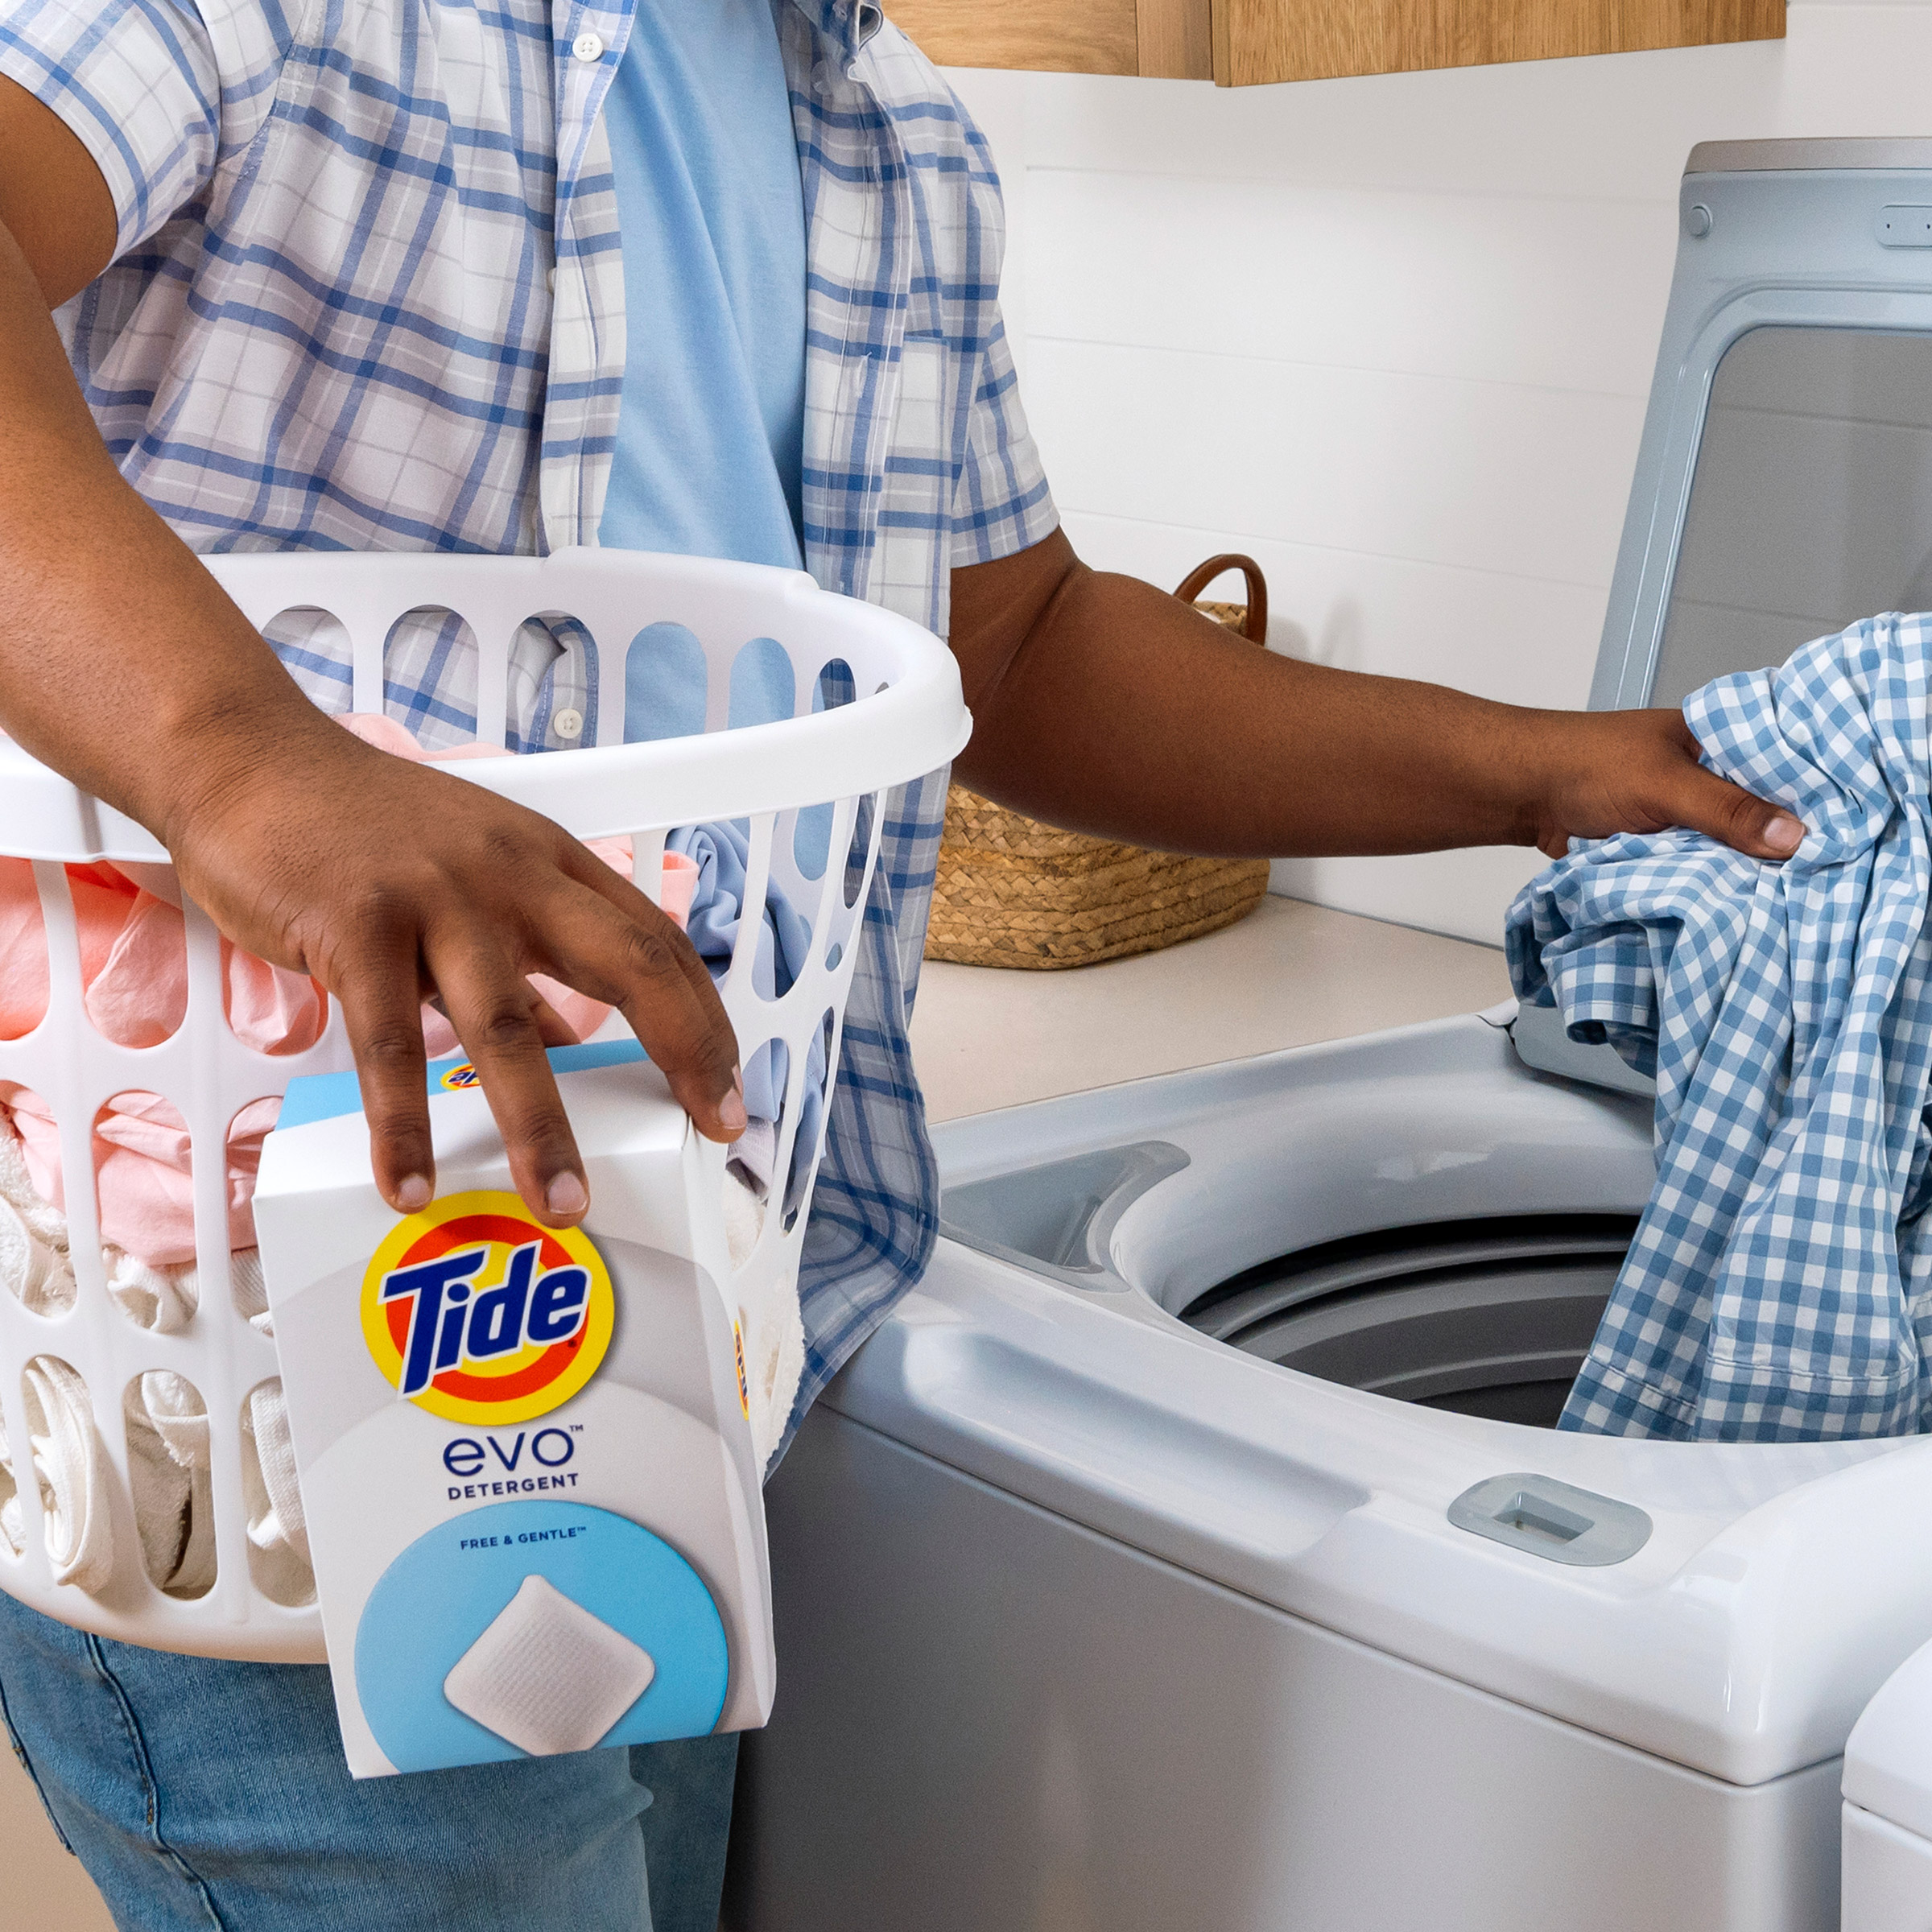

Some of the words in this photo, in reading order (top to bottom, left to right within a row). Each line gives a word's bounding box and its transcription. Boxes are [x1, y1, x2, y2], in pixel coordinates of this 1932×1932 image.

[378, 1238, 592, 1399] Tide
[448, 1472, 579, 1501] DETERGENT
[460, 1536, 498, 1550] FREE
[503, 1535, 513, 1545] &
